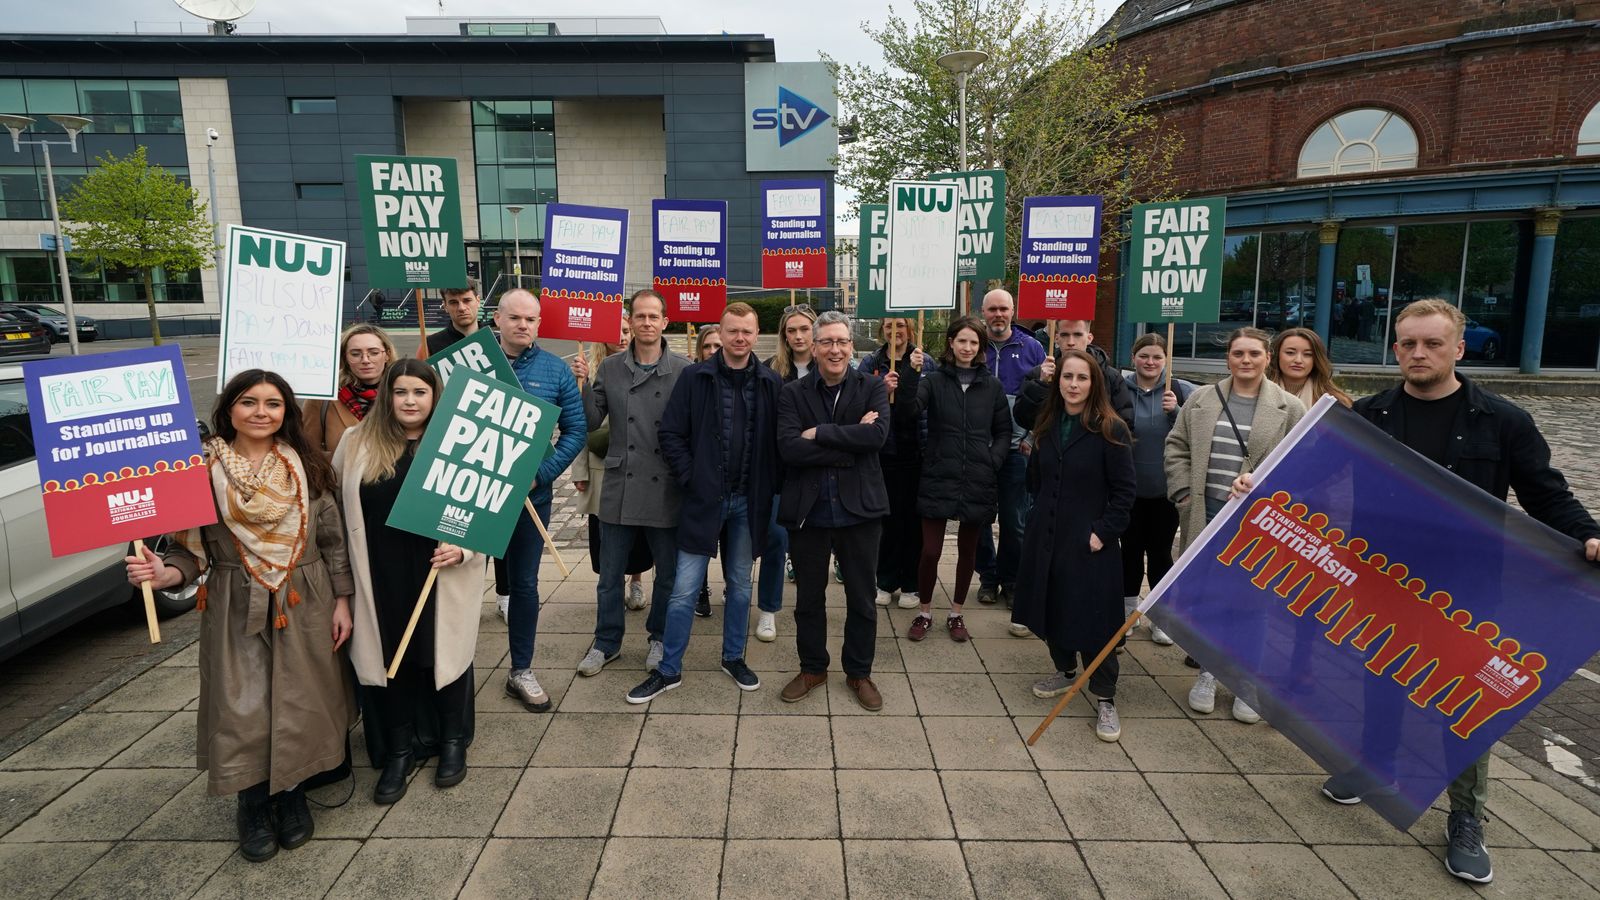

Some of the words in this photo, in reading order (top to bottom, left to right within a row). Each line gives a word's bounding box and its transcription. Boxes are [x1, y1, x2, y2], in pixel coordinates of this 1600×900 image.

[752, 103, 818, 129] stv
[370, 162, 445, 192] FAIR
[940, 176, 994, 200] AIR
[374, 194, 445, 228] PAY
[897, 187, 953, 213] NUJ
[771, 219, 805, 229] Standing
[807, 220, 817, 229] up
[959, 202, 994, 231] AY
[1144, 206, 1209, 234] FAIR
[558, 219, 585, 239] FAIR
[592, 225, 616, 241] PAY
[767, 231, 778, 239] for
[780, 230, 821, 239] Journalism
[238, 234, 333, 277] NUJ
[378, 231, 449, 258] NOW
[663, 244, 703, 255] Standing
[704, 246, 716, 256] up
[959, 232, 995, 256] OW
[1033, 241, 1074, 252] Standing
[1075, 243, 1087, 252] up
[1142, 235, 1209, 267] PAY
[405, 262, 429, 271] NUJ
[555, 253, 599, 268] Standing
[601, 258, 614, 268] up
[659, 257, 671, 267] for
[673, 257, 720, 268] Journalism
[785, 261, 804, 269] NUJ
[959, 258, 977, 267] NUJ
[1027, 254, 1040, 263] for
[1041, 254, 1092, 264] Journalism
[549, 266, 563, 277] for
[564, 267, 618, 282] Journalism
[1141, 269, 1207, 294] NOW
[679, 292, 700, 301] NUJ
[1045, 289, 1068, 298] NUJ
[1162, 297, 1184, 306] NUJ
[568, 306, 592, 317] NUJ
[235, 310, 275, 338] PAY
[283, 314, 335, 338] DOWN
[229, 347, 265, 369] FAIR
[431, 342, 492, 387] AIR
[47, 375, 122, 415] FAIR
[122, 367, 176, 401] PAY!
[456, 377, 542, 440] FAIR
[59, 416, 147, 441] Standing
[149, 411, 173, 429] up
[51, 446, 81, 463] for
[85, 428, 188, 457] Journalism
[438, 414, 530, 477] PAY
[107, 487, 154, 508] NUJ
[422, 458, 514, 514] NOW
[111, 508, 157, 522] JOURNALISTS
[443, 504, 474, 523] NUJ
[1269, 510, 1296, 529] STAND
[1293, 525, 1307, 535] UP
[1304, 532, 1322, 546] FOR
[1250, 505, 1358, 587] Journalism
[1487, 655, 1530, 686] NUJ
